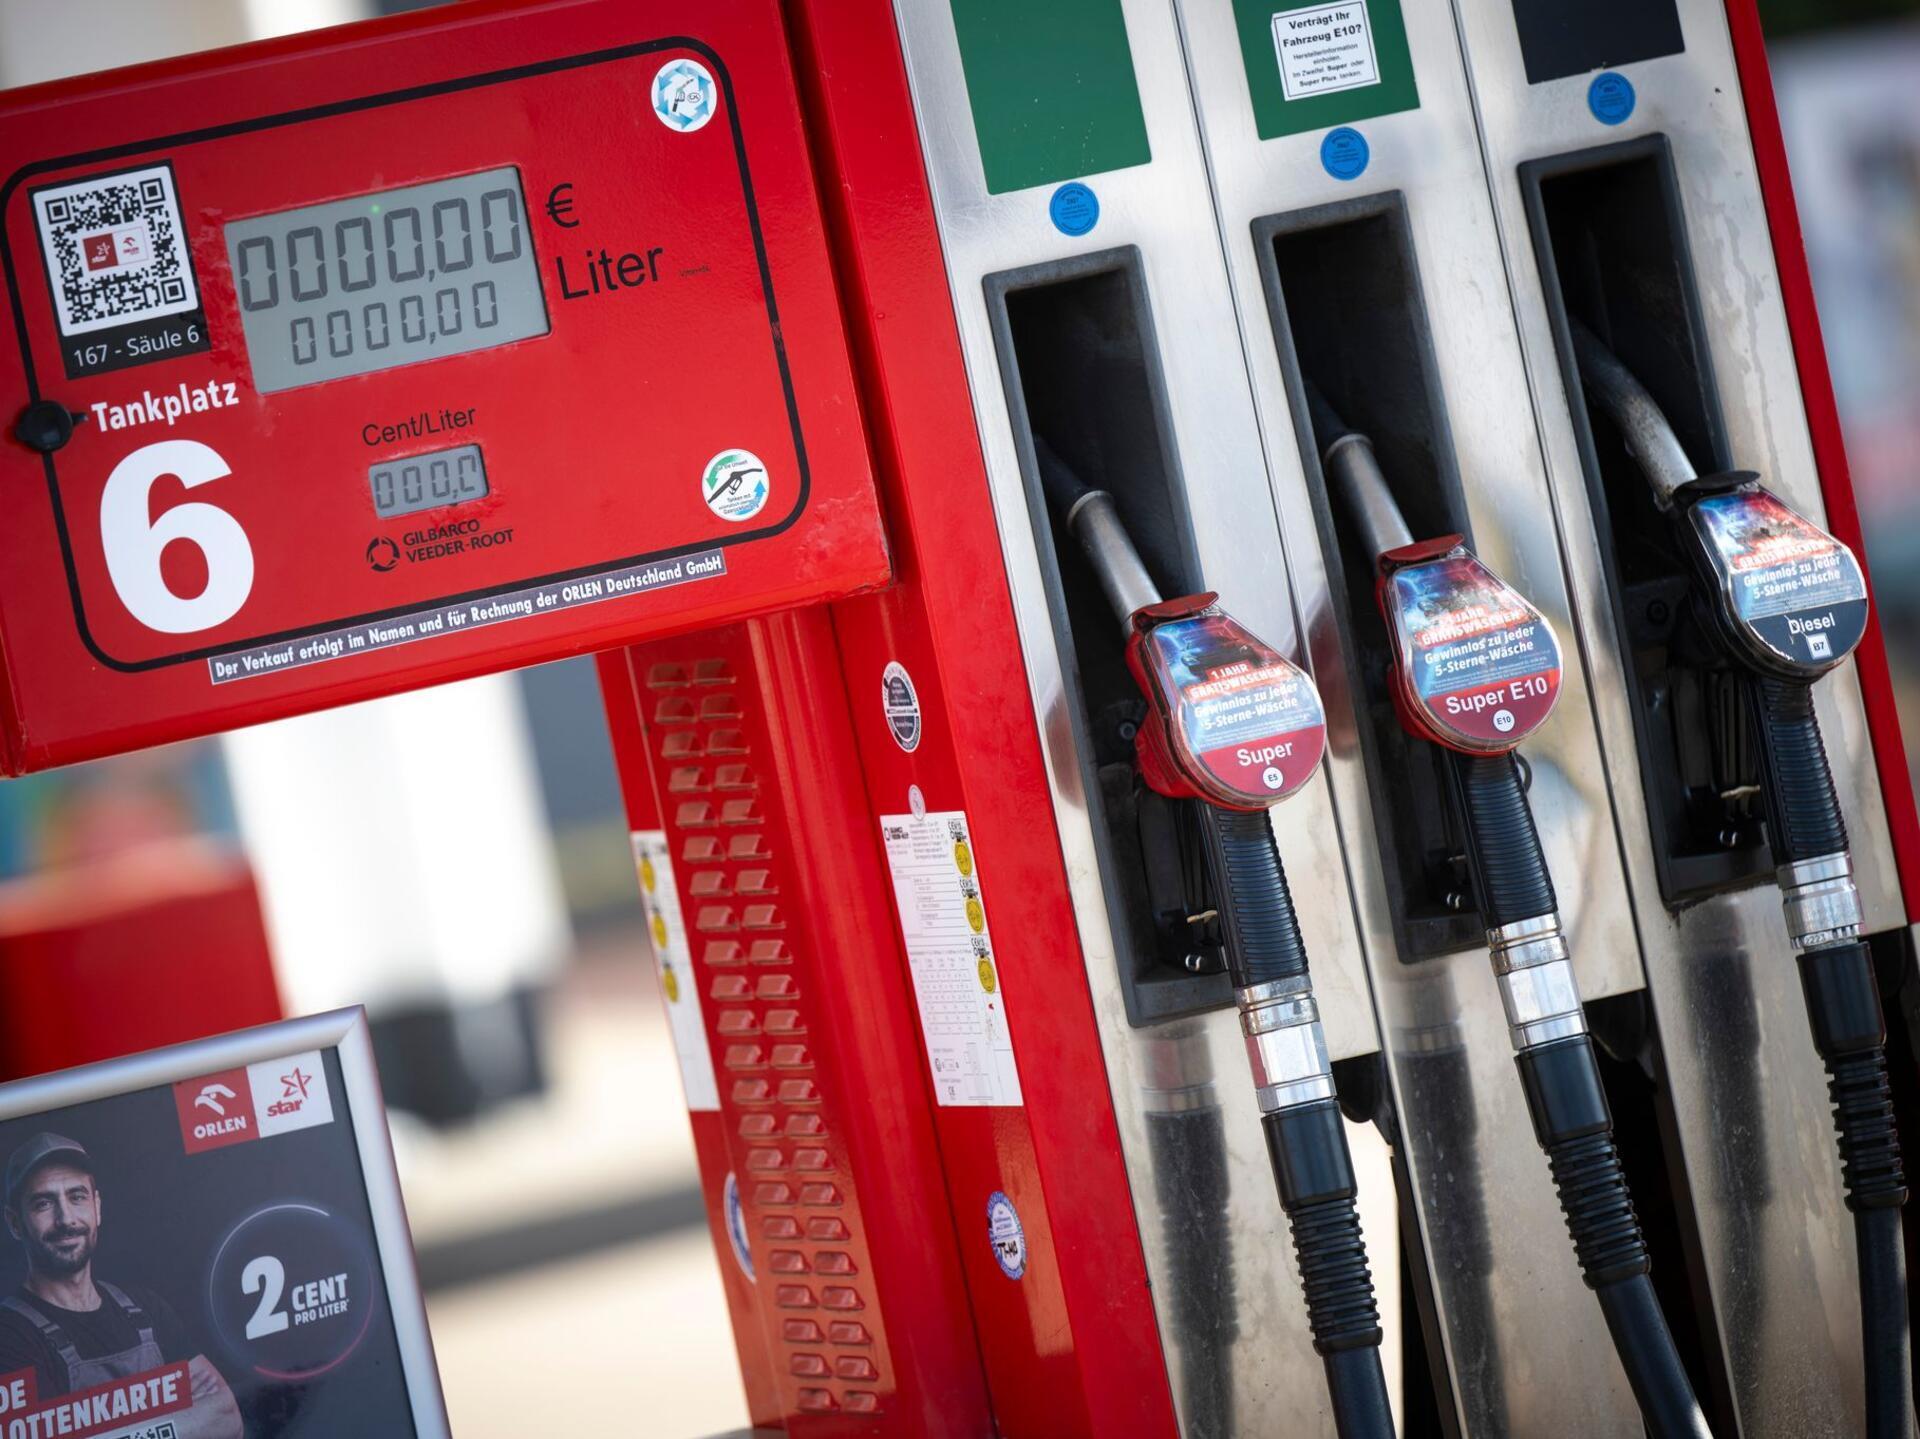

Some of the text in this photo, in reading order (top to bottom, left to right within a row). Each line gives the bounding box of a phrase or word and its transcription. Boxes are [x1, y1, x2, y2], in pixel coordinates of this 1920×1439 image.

[1336, 12, 1350, 21] Ihr
[1283, 24, 1362, 47] Fahrzeug E10?
[1299, 79, 1319, 87] Super
[1322, 75, 1337, 83] Plus
[1327, 63, 1347, 73] Super
[546, 183, 579, 228] €
[556, 247, 663, 300] Liter
[73, 345, 108, 367] 167
[126, 331, 182, 357] Säule
[187, 325, 199, 343] 6
[91, 380, 239, 432] Tankplatz
[362, 408, 476, 446] Cent/Liter
[100, 439, 254, 634] 6
[403, 519, 480, 546] GILBARCO
[406, 529, 514, 563] VEEDER-ROOT
[1744, 565, 1797, 587] Gewinnlos
[1799, 563, 1811, 574] zu
[1753, 569, 1841, 600] 5-Sterne-Wäsche
[215, 555, 722, 677] Der Verkauf erfolgt im Namen und für Rechnung der ORLEN Deutschland GmbH
[1788, 613, 1836, 635] Diesel
[1424, 625, 1535, 664] Gewinnlos zu jeder
[1435, 641, 1534, 677] 5-Sterne-Wäsche
[1812, 641, 1825, 651] B7
[1194, 682, 1298, 718] Gewinnlos zu jeder
[1446, 676, 1548, 714] Super E10
[1203, 697, 1298, 730] 5-Sterne-Wäsche
[1497, 715, 1511, 725] E10
[1236, 741, 1292, 767] Super
[1267, 773, 1278, 782] E5
[267, 1099, 303, 1117] star
[194, 1115, 247, 1139] ORLEN
[241, 1256, 348, 1340] 2 CENT
[294, 1308, 317, 1326] PRO
